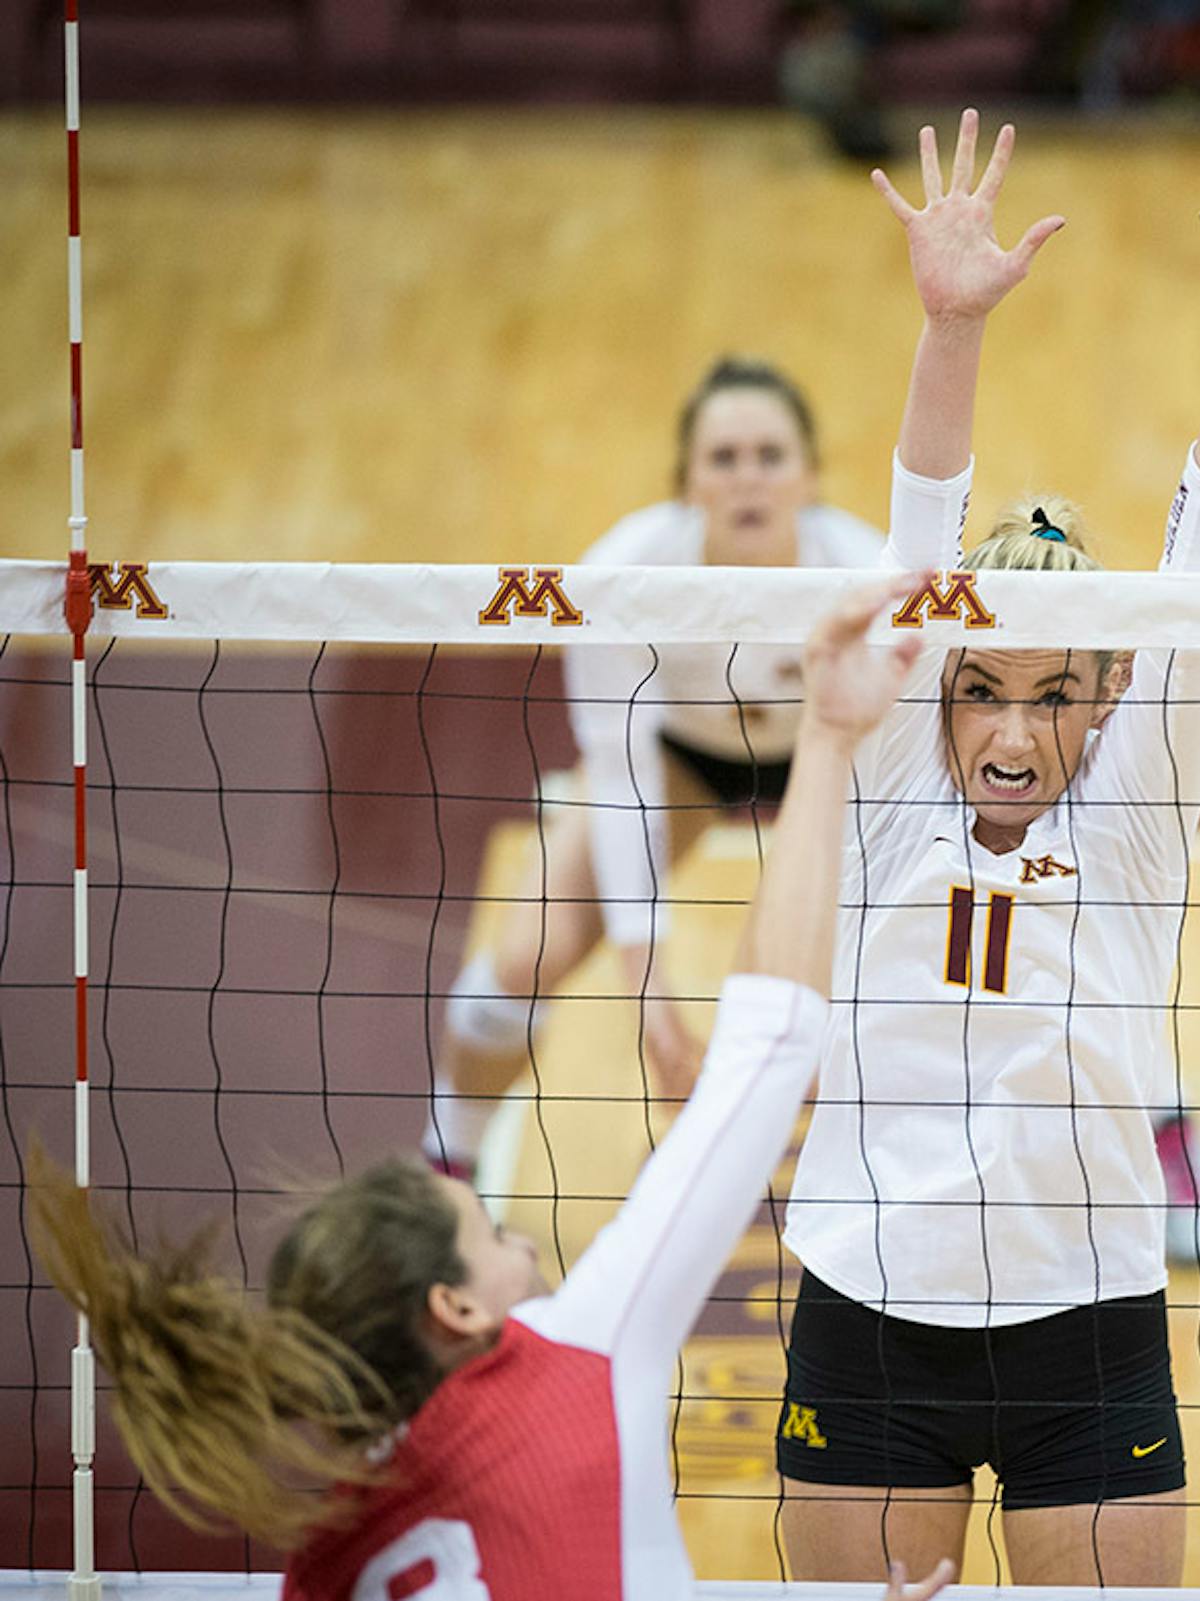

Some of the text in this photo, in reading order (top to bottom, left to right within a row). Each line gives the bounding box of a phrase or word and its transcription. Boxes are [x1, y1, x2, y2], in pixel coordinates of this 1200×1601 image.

[478, 567, 583, 626] M
[891, 570, 996, 629] M
[944, 884, 1016, 995] 11
